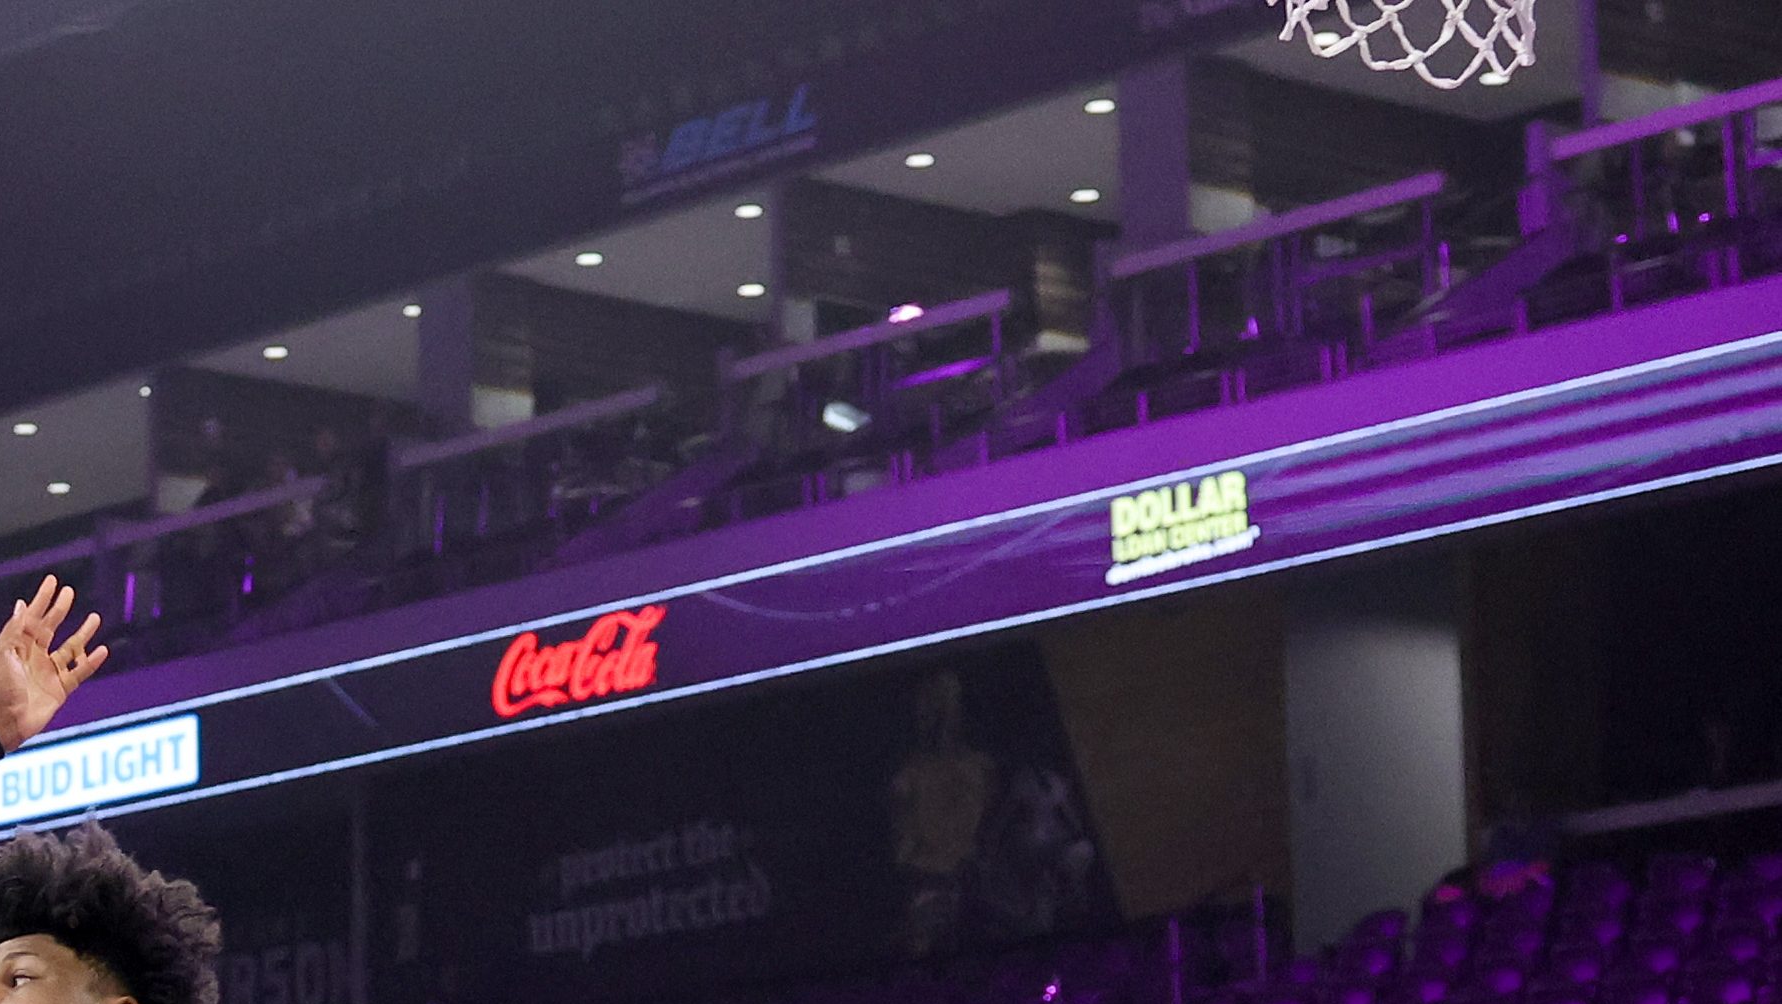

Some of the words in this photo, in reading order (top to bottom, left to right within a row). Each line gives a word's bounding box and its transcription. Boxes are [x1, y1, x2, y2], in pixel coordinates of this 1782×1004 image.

[1110, 470, 1248, 538] DOLLAR
[1, 759, 73, 807] BUD
[82, 732, 187, 790] LIGHT
[527, 857, 773, 962] unprotected
